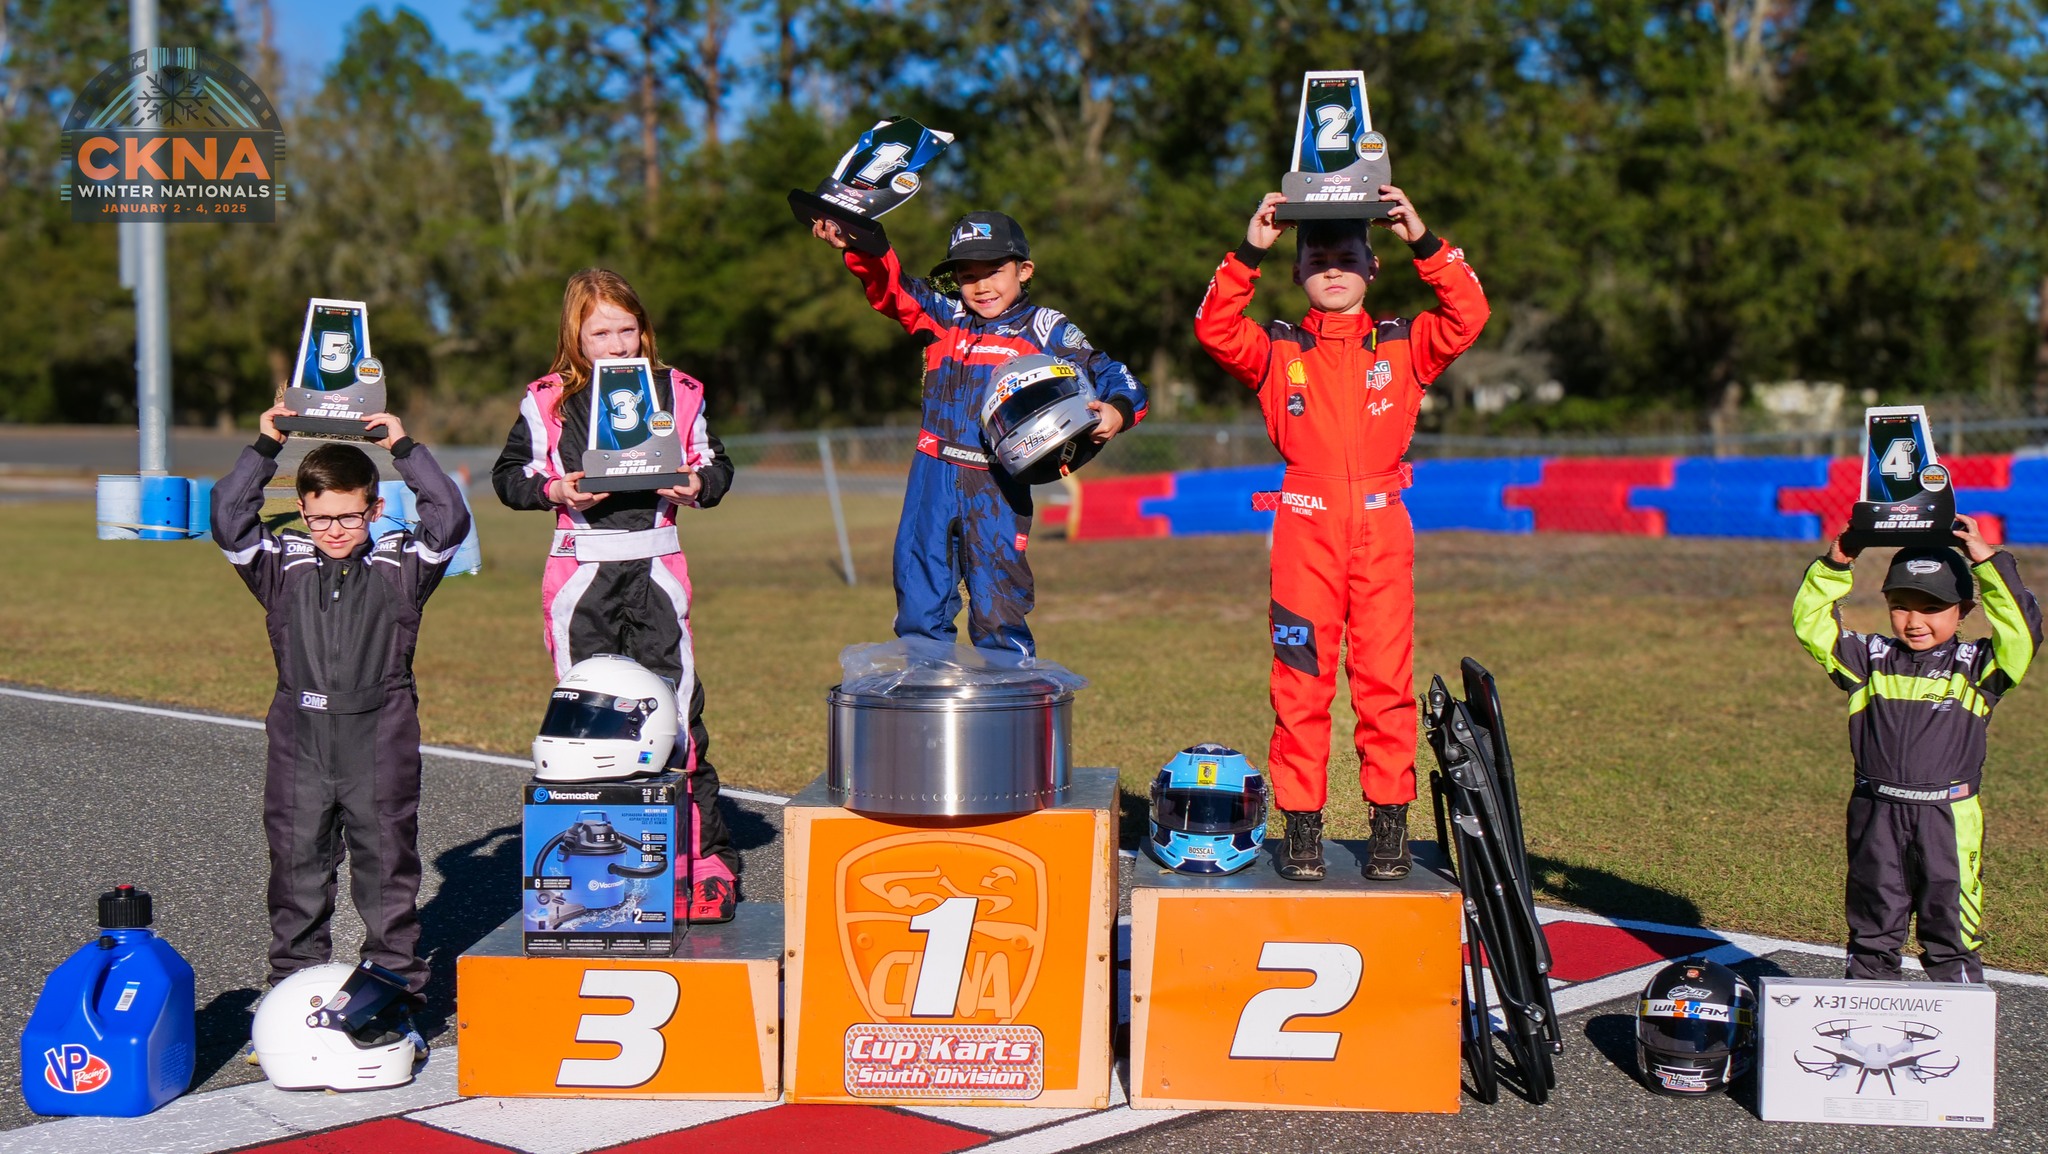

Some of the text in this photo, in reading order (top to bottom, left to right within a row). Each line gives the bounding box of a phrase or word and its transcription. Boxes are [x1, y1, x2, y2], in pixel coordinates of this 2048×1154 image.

[1320, 185, 1352, 193] 2025
[835, 192, 860, 205] 2025
[1304, 193, 1367, 201] KID KART
[820, 193, 840, 205] KID
[840, 201, 866, 214] KART
[988, 371, 1042, 411] GRANT
[320, 402, 349, 410] 2025
[305, 408, 364, 419] KID KART
[619, 459, 648, 467] 2025
[605, 465, 662, 475] KID KART
[1282, 491, 1327, 511] BOSSCAL
[1291, 506, 1313, 517] RACING
[1888, 513, 1918, 521] 2025
[1874, 520, 1934, 529] KID KART
[287, 543, 314, 553] OMP
[1273, 624, 1309, 646] 23
[302, 694, 328, 707] OMP
[552, 691, 579, 700] zamp
[548, 790, 600, 800] Vacmaster
[1877, 784, 1949, 801] HECKMAN
[642, 833, 651, 841] 55
[642, 844, 651, 852] 48
[1188, 846, 1215, 855] BOSSCAL
[641, 854, 653, 862] 100
[534, 878, 541, 889] 6
[633, 908, 642, 924] 2
[908, 897, 979, 1018] 1
[1229, 941, 1364, 1061] 2
[1813, 995, 1943, 1012] X-31 SHOCKWAVE
[1653, 1003, 1729, 1018] WILLIAM
[555, 969, 681, 1089] 3
[851, 1035, 1034, 1067] Cup Karts
[44, 1044, 89, 1093] VP
[76, 1067, 108, 1087] Racing
[857, 1066, 1030, 1089] South Division
